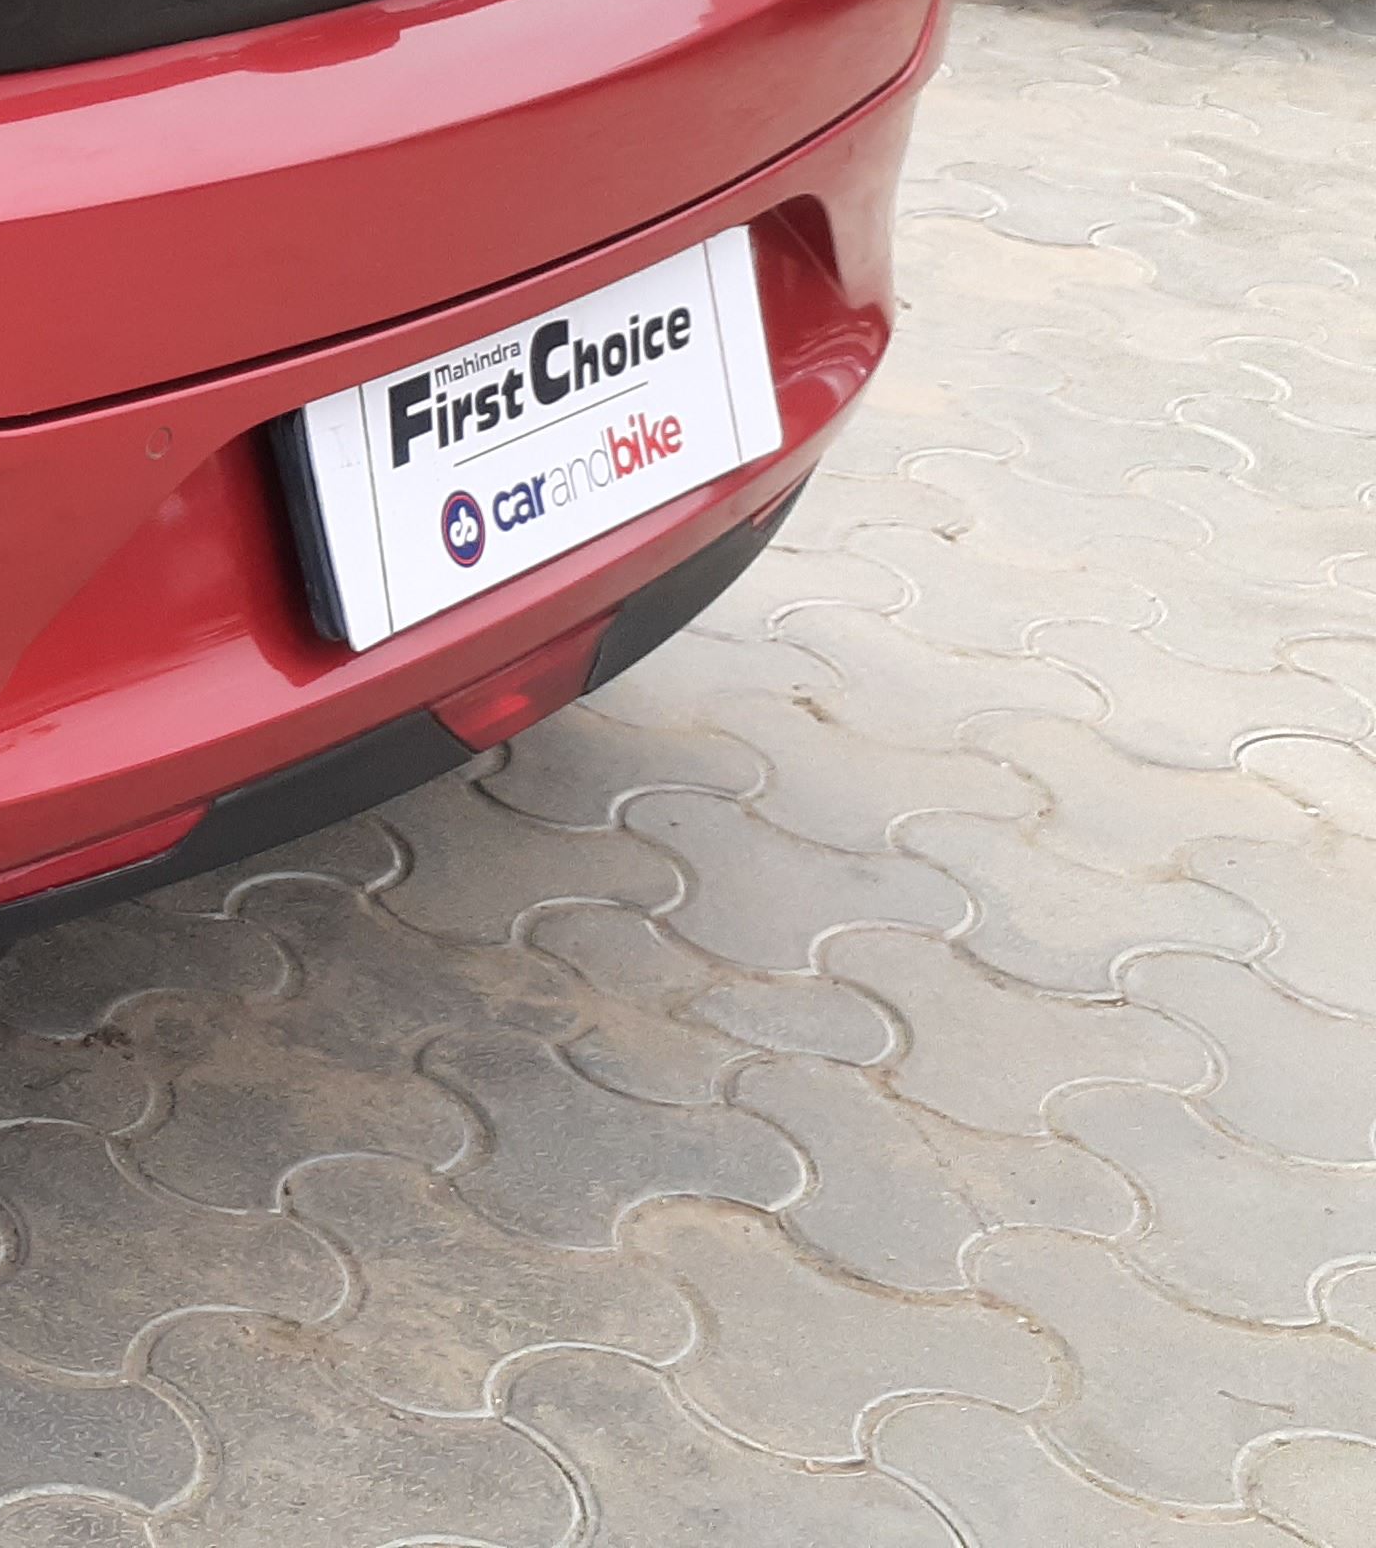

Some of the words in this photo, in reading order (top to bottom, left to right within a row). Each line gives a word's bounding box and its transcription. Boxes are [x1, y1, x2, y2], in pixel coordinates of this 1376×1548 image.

[388, 369, 525, 469] First
[529, 306, 692, 406] Choice
[434, 340, 522, 389] Mahindra
[492, 413, 684, 532] carandbike
